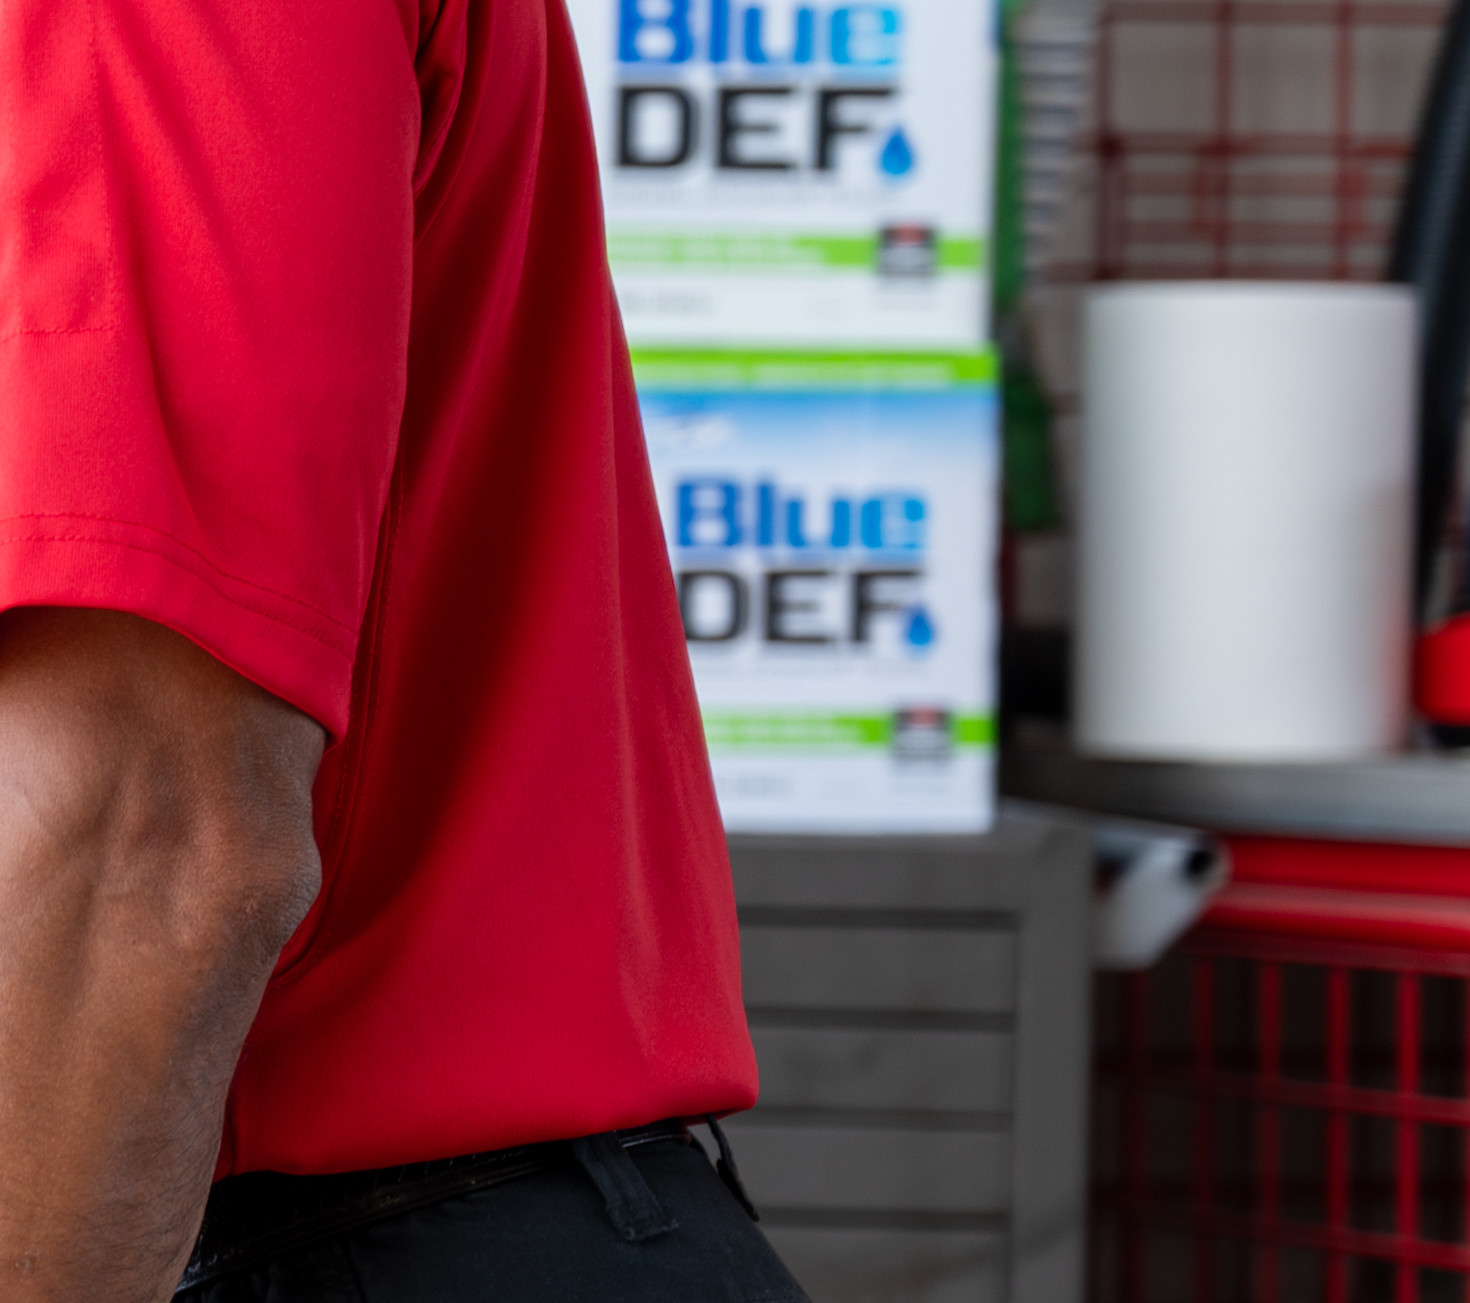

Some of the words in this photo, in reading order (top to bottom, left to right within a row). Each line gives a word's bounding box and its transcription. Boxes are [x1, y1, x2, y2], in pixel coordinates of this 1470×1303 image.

[613, 84, 899, 173] DEF
[674, 475, 927, 550] Blue
[675, 568, 925, 645] DEF
